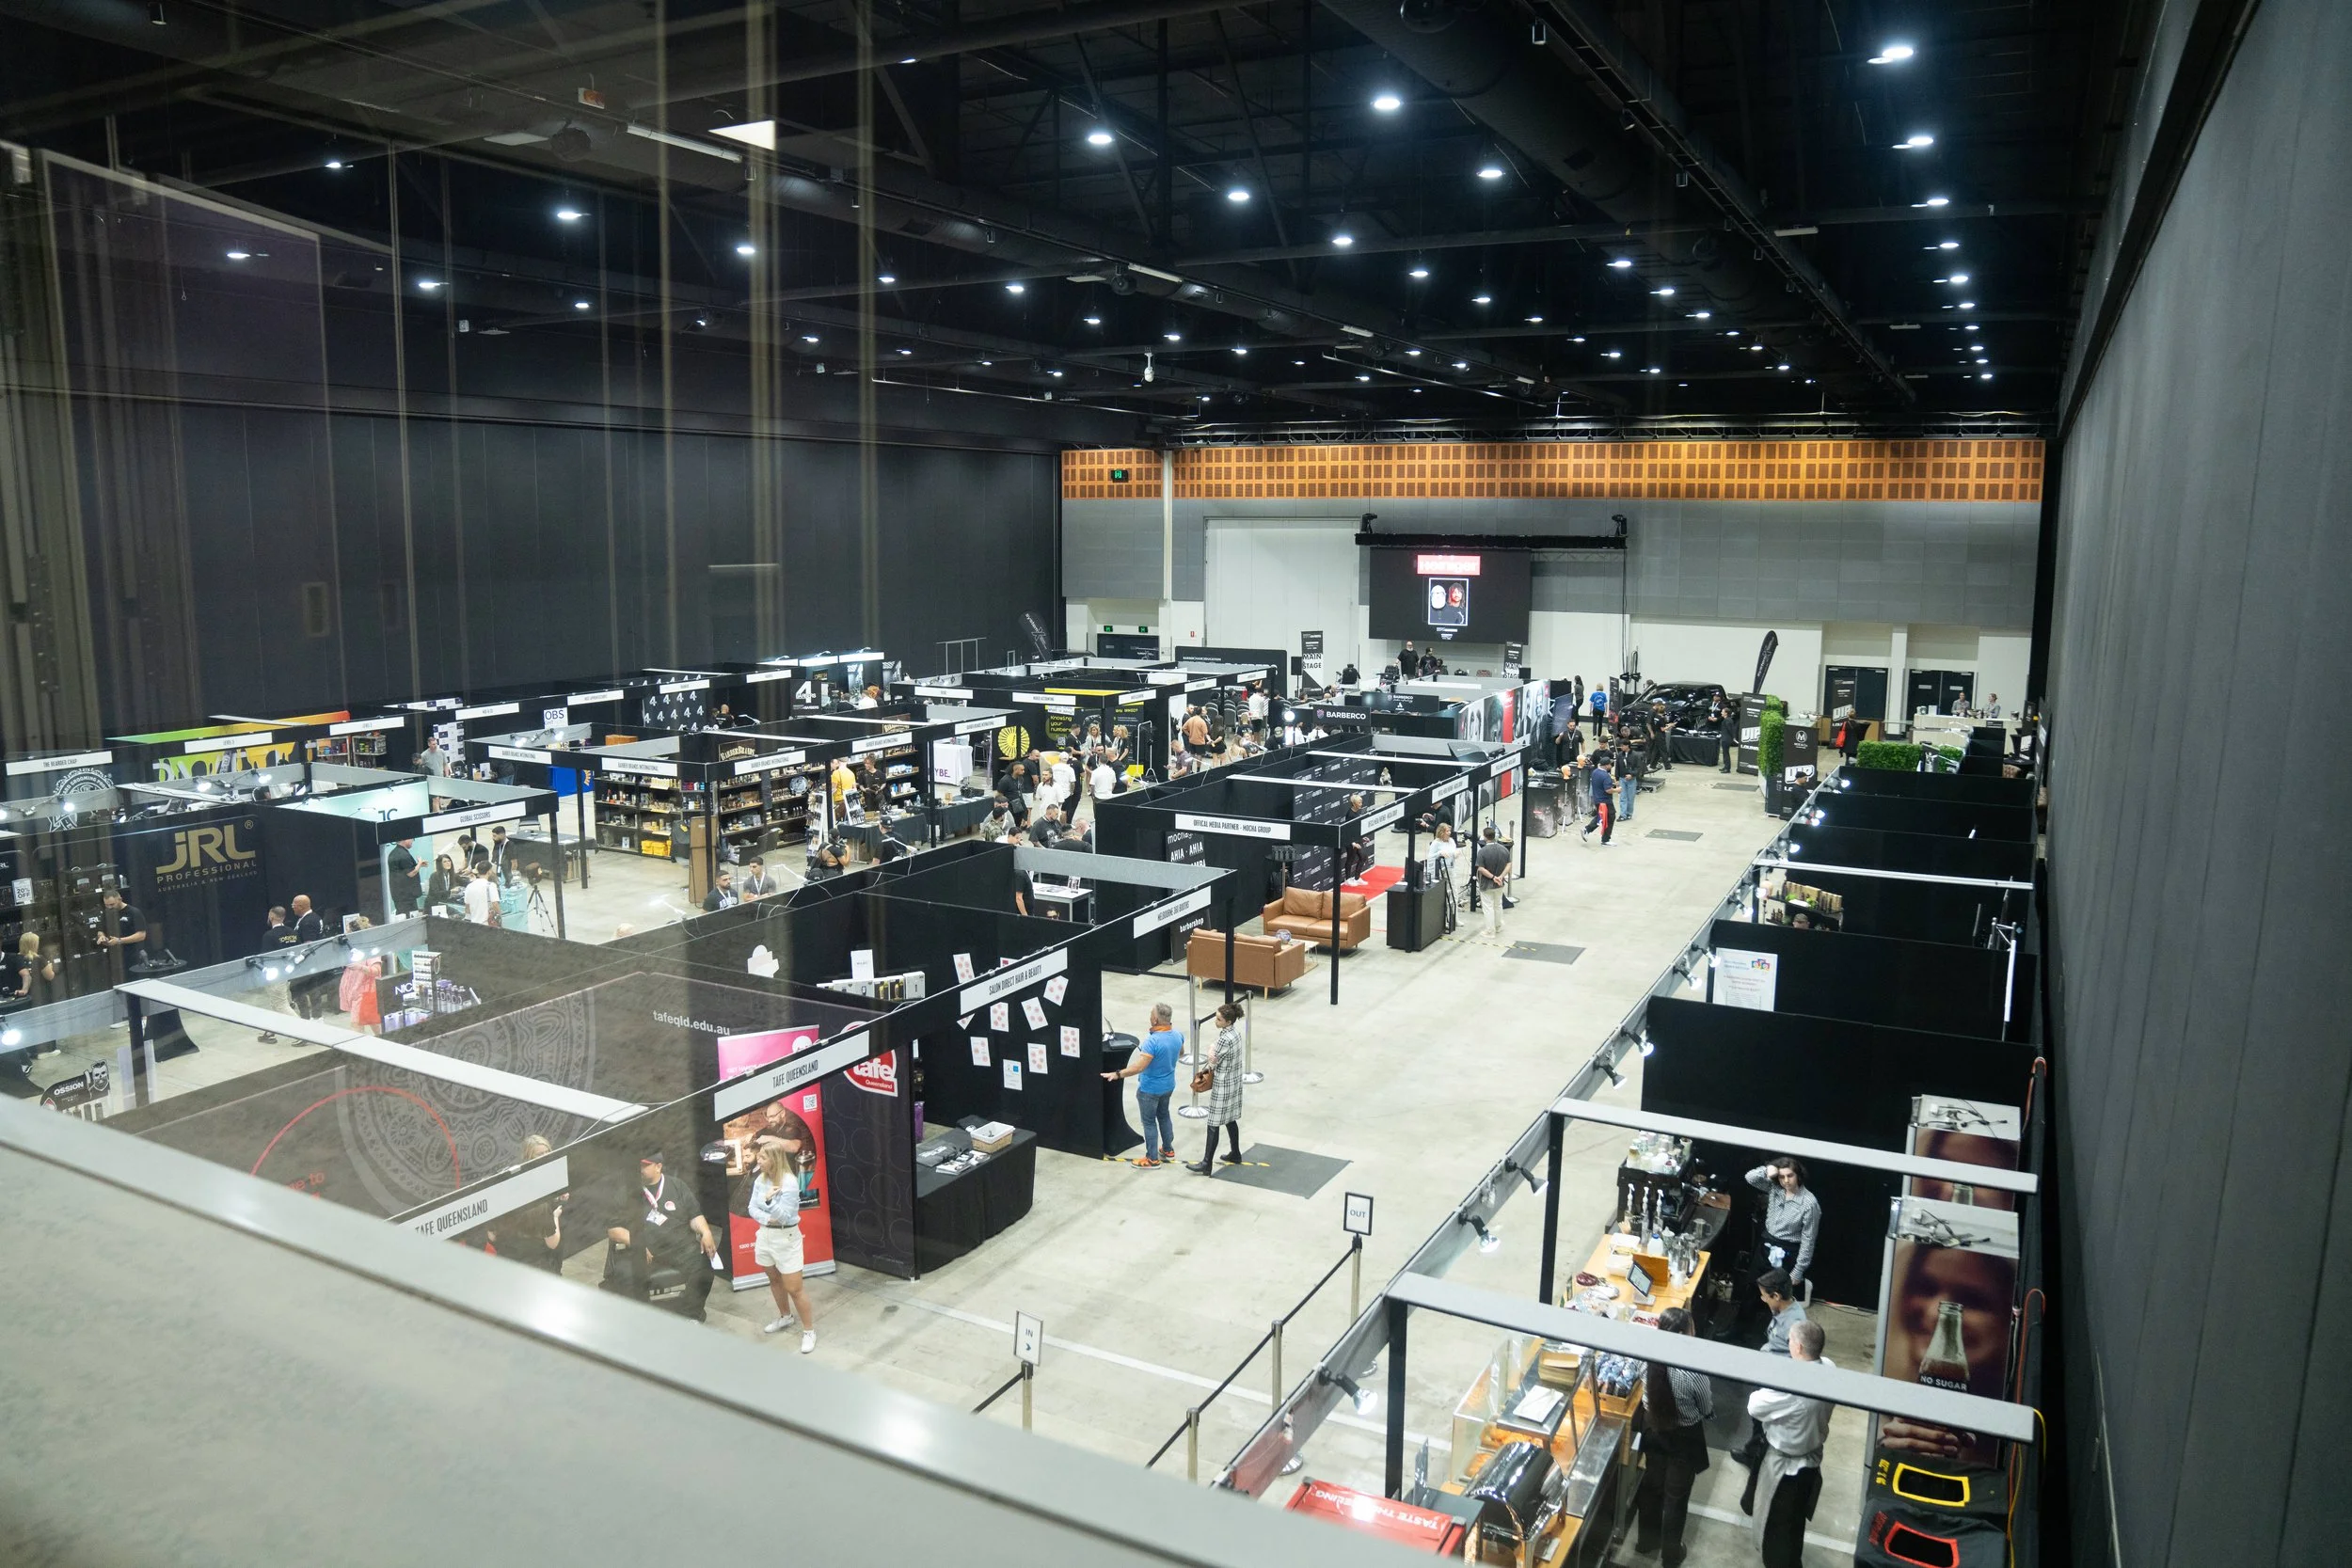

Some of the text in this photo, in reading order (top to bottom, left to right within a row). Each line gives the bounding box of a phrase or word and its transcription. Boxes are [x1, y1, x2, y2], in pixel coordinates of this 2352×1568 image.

[676, 692, 684, 703] 4
[690, 690, 697, 701] 4
[796, 680, 811, 704] 4
[649, 696, 657, 706] 4
[663, 694, 671, 705] 4
[545, 710, 564, 721] OBS
[657, 711, 664, 721] 4
[671, 709, 677, 720] 4
[684, 707, 691, 718] 4
[697, 705, 704, 716] 4
[1327, 711, 1366, 720] BARBERCO
[644, 713, 651, 723] 4
[460, 811, 491, 823] GLOBAL SCISSORS
[1243, 824, 1257, 832] MOCHA
[1170, 848, 1184, 863] AHIA
[1189, 841, 1203, 856] AHIA
[157, 860, 257, 883] PROFESSIONAL
[158, 881, 198, 893] AUSTRALIA
[228, 870, 258, 880] ZEALAND
[1157, 905, 1173, 922] MELBOURNE
[1179, 900, 1189, 913] BOOTHS
[1180, 917, 1204, 933] barbershop
[989, 983, 1001, 995] SALON
[1001, 975, 1014, 990] DIRECT
[1015, 972, 1025, 985] HAIR
[1028, 964, 1042, 978] BEAUTY
[653, 1010, 730, 1036] tafeqld.edu.au
[772, 1059, 818, 1088] TAFE QUEENSLAND
[853, 1058, 894, 1081] tafe
[54, 1082, 84, 1096] OSSION
[866, 1079, 893, 1090] Queensland
[437, 1198, 488, 1232] QUEENSLAND
[1350, 1209, 1366, 1218] OUT
[1025, 1328, 1033, 1338] IN
[1920, 1375, 1967, 1391] NO SUGAR
[1397, 1512, 1438, 1529] TASTE
